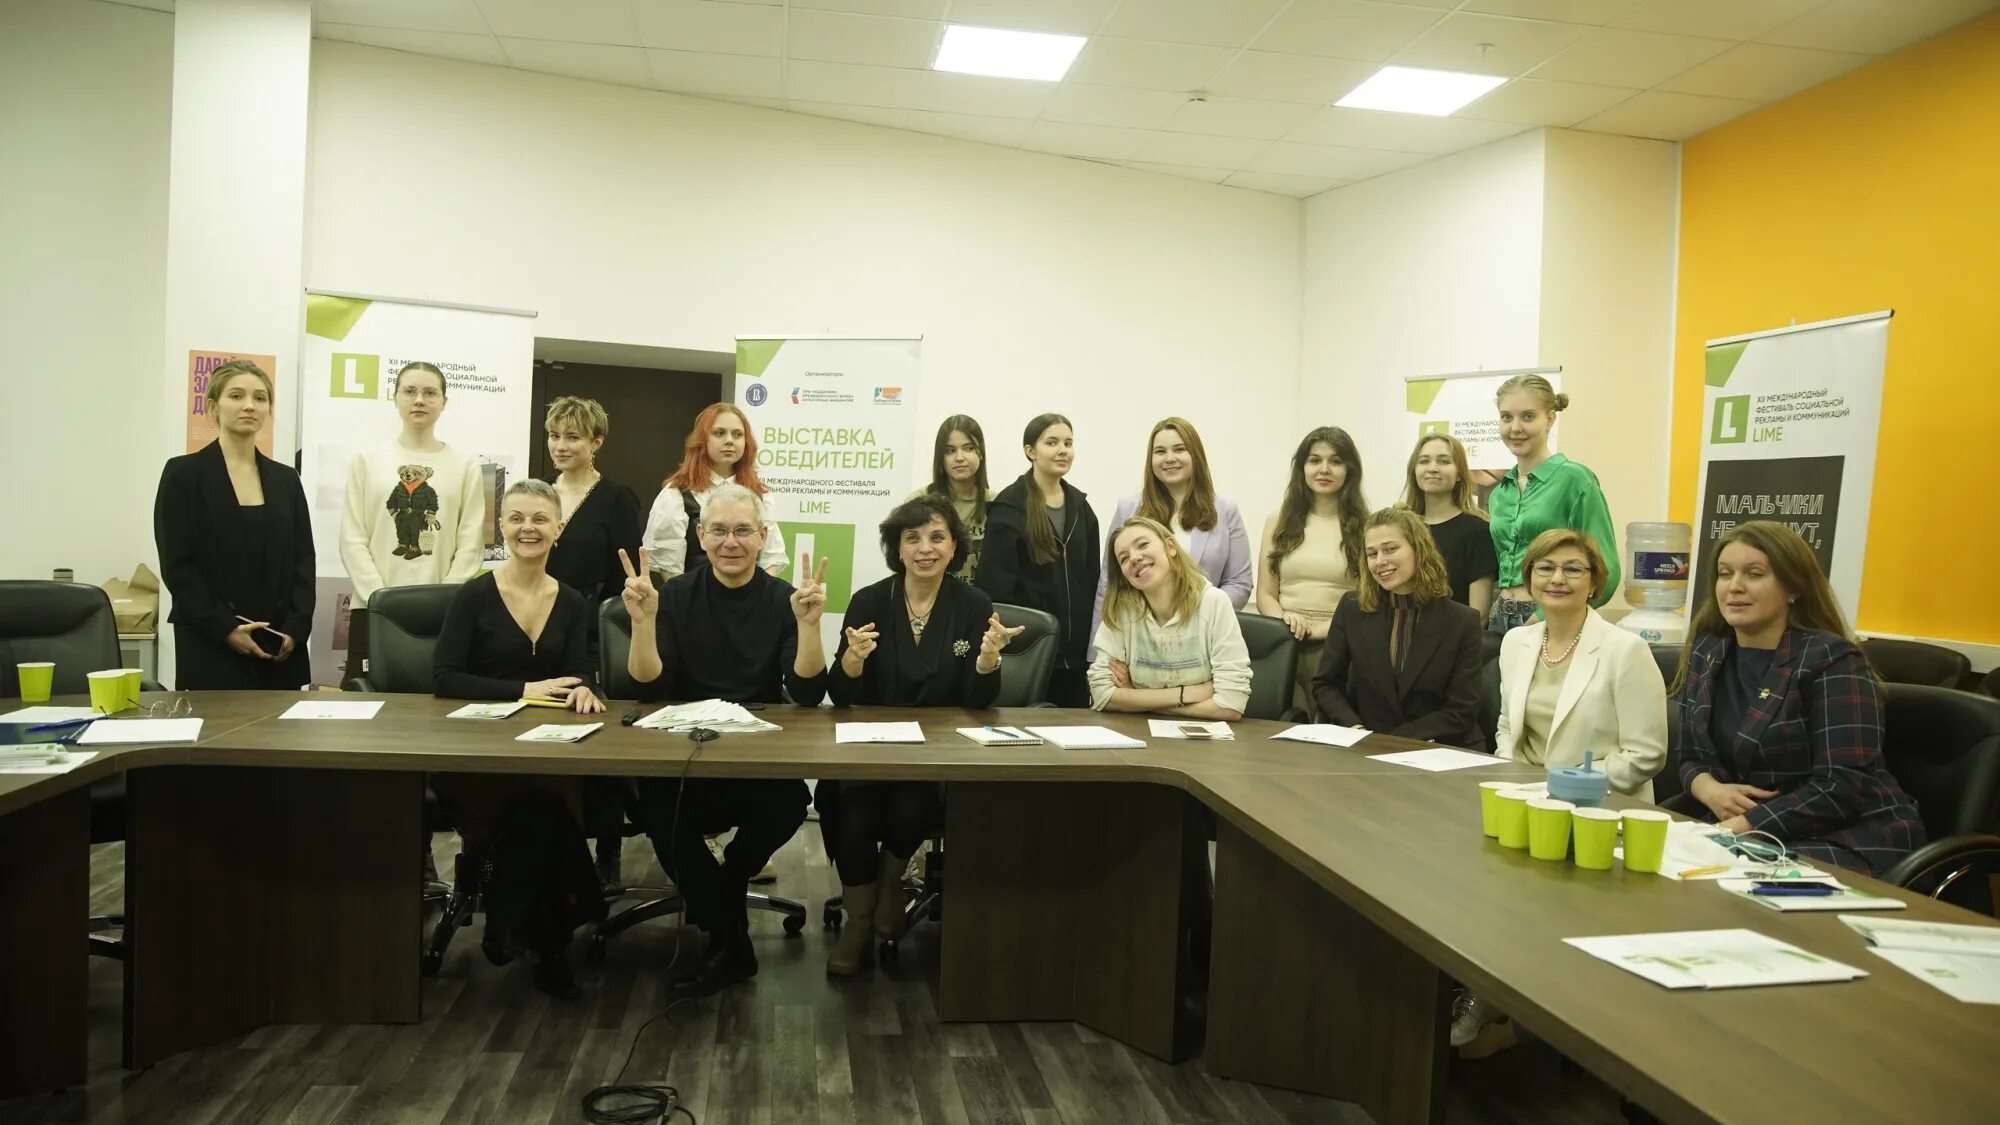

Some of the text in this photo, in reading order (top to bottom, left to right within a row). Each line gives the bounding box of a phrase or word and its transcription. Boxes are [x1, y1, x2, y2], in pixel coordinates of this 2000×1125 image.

[389, 358, 398, 366] XII
[400, 360, 476, 372] МЕАРОДНЫЙ
[344, 359, 364, 393] L
[445, 372, 498, 383] ОЦИАЛЬНОЙ
[1767, 388, 1828, 402] МЕЖДУНАРОДНЫЙ
[1756, 397, 1844, 413] ФЕСТИВАЛЬ СОЦИАЛЬНОЙ
[1721, 401, 1736, 438] L
[1755, 416, 1785, 424] РЕКЛАМЫ
[1793, 408, 1850, 421] КОММУНИКАЦИЙ
[764, 427, 876, 446] ВЫСТАВКА
[1753, 427, 1783, 442] LIME
[757, 448, 894, 471] ОБЕДИТЕЛЕЙ
[767, 478, 834, 486] МЕЖДУНАРОДНОГО
[835, 479, 876, 487] ФЕСТИВАЛЯ
[792, 487, 825, 495] РЕКЛАМЫ
[833, 488, 890, 497] КОММУНИКАЦИЙ
[799, 501, 831, 514] LIME
[1716, 494, 1824, 515] МАЛЬЧИКИ
